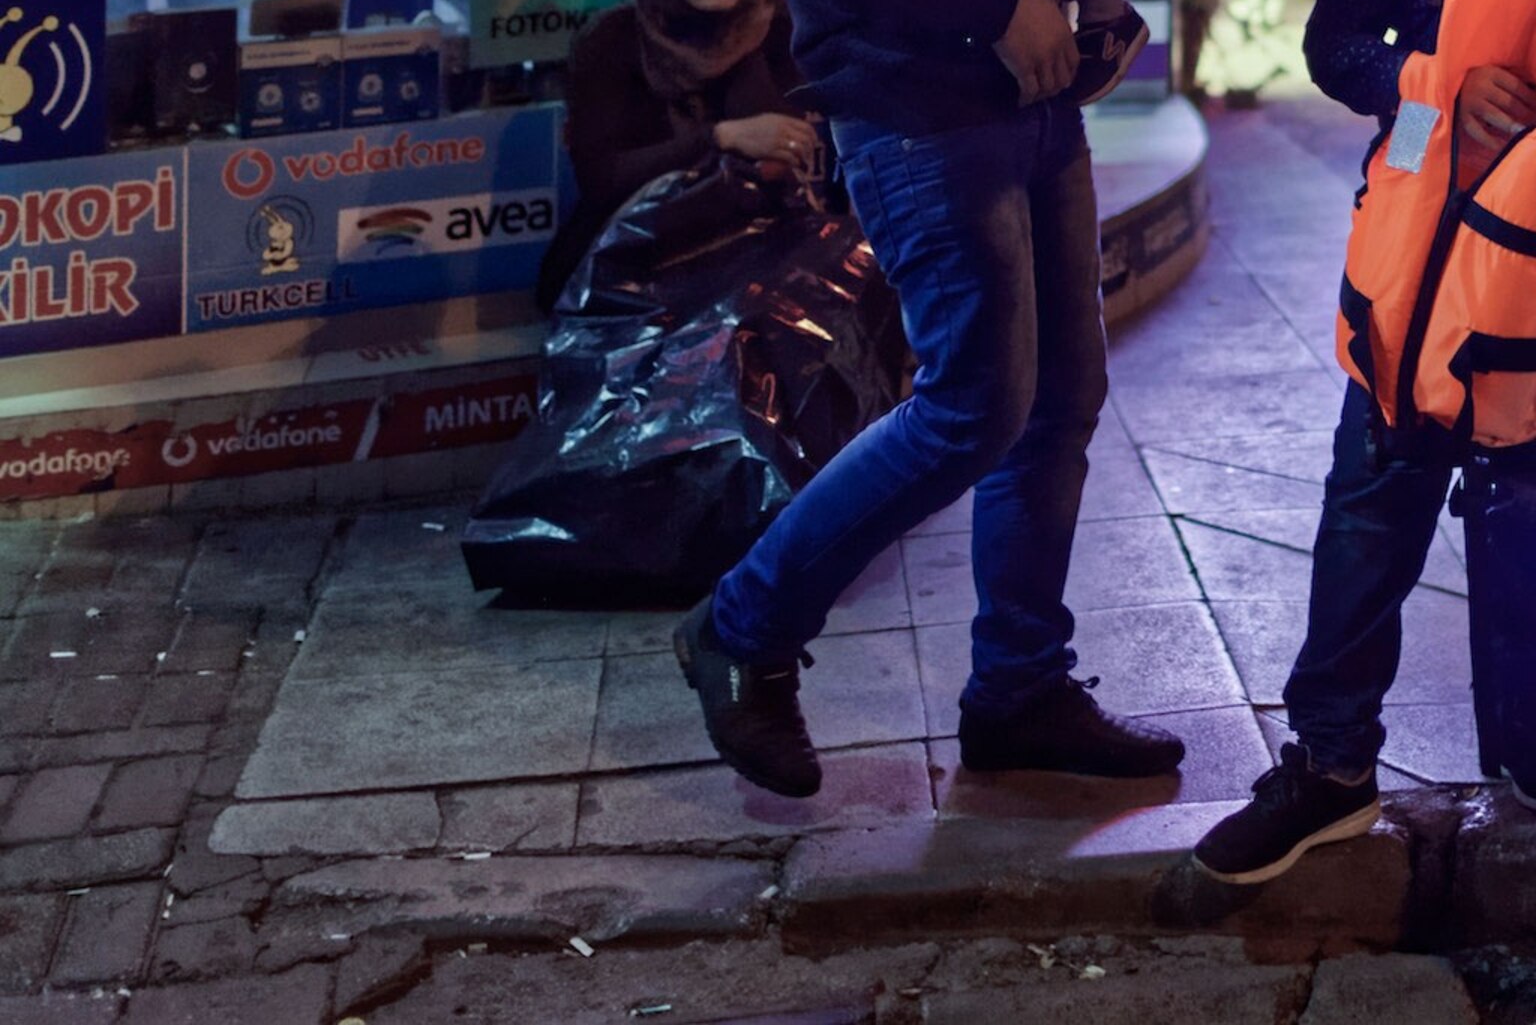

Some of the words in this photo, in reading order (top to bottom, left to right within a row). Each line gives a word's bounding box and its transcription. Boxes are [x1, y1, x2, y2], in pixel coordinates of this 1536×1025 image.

[490, 10, 590, 39] FOTOK
[283, 132, 485, 181] vodafone
[445, 197, 554, 241] avea
[199, 279, 361, 321] TURKCELL
[424, 392, 533, 433] MİNTA
